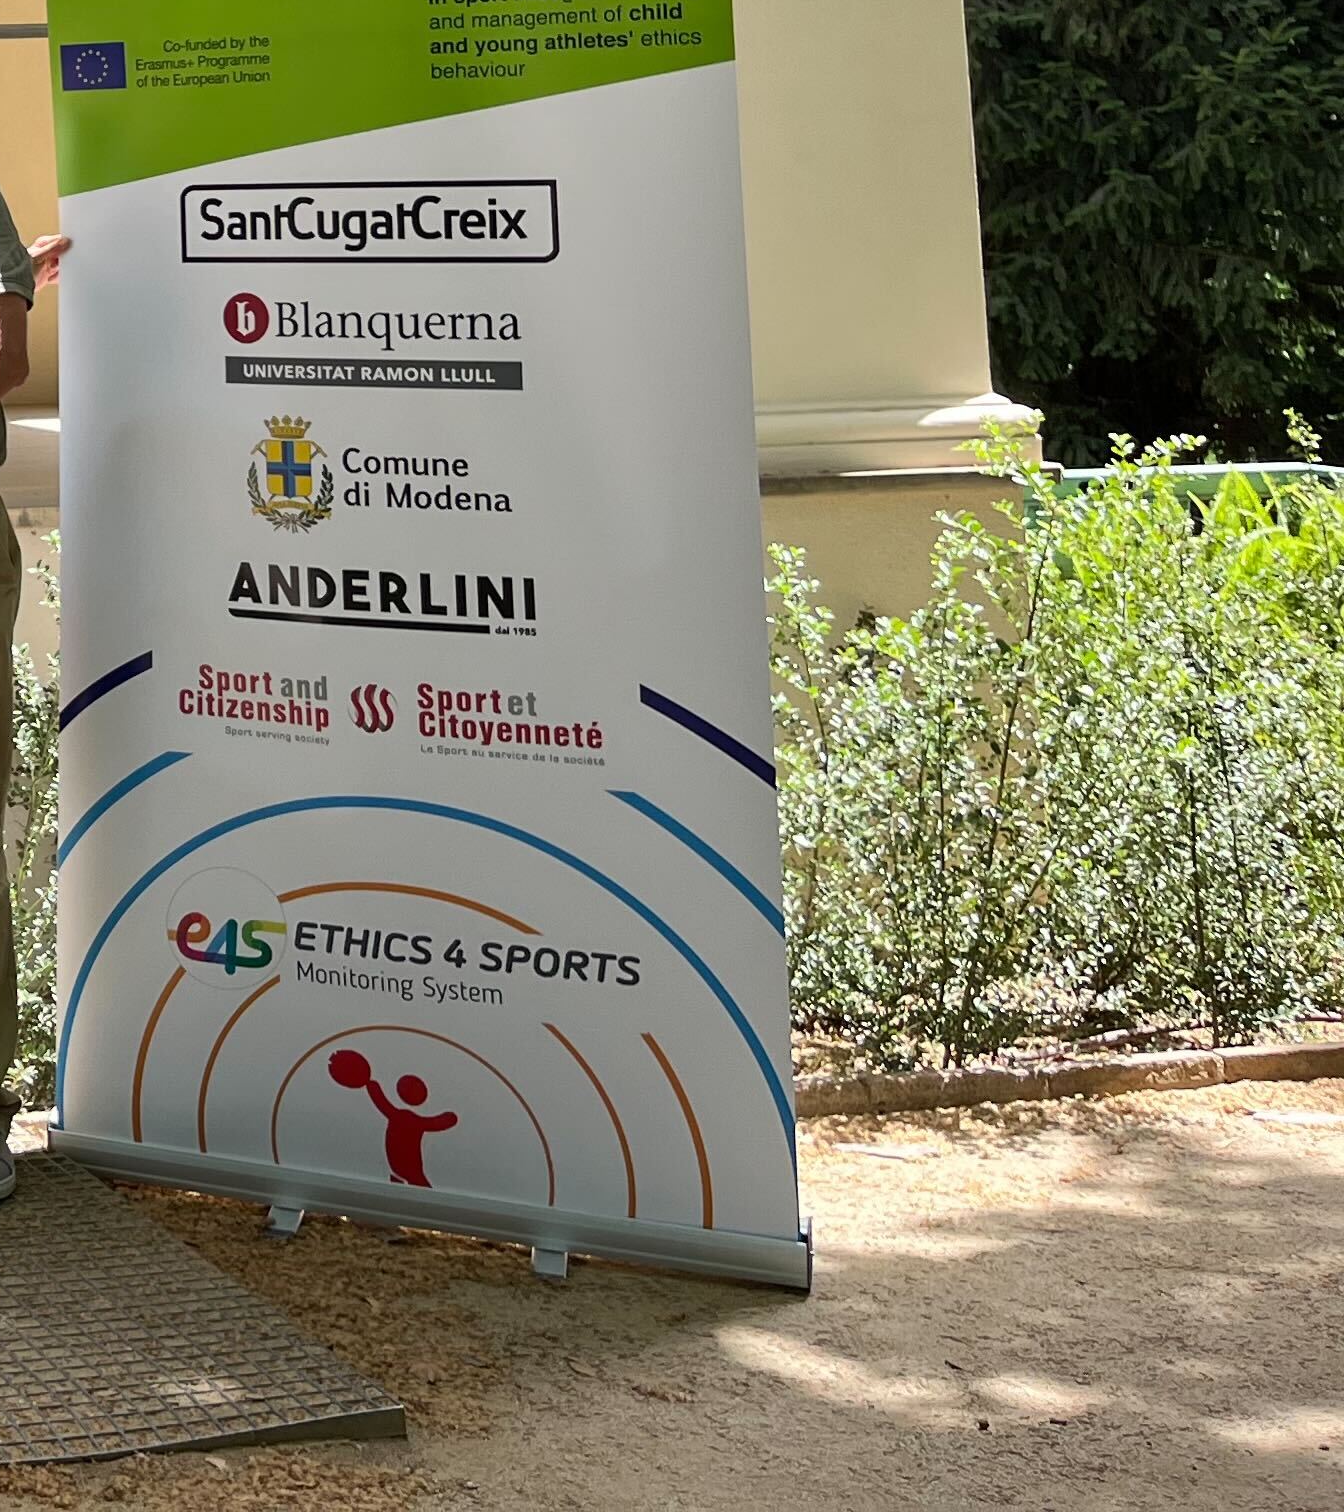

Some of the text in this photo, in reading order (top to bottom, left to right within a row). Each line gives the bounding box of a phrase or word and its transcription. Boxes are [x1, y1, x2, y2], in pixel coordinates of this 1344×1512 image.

[429, 3, 683, 30] and management of child
[163, 36, 270, 53] Co-funded by the
[430, 30, 702, 56] and young athletes' ethics
[135, 54, 270, 71] Erasmus+ Programme
[431, 63, 526, 80] behaviour
[136, 71, 270, 88] of the European Union
[200, 195, 528, 252] SantCugatCreix
[274, 301, 522, 351] Blanquerna
[243, 364, 496, 384] UNIVERSITAT RAMON LLULL
[342, 447, 469, 477] Comune
[343, 481, 513, 512] di Modena
[228, 561, 537, 620] ANDERLINI
[513, 627, 537, 637] 1985
[198, 664, 328, 700] Sport and
[179, 688, 330, 732] Citizenship
[417, 683, 537, 717] Sport et
[224, 725, 253, 737] Sport
[419, 711, 603, 749] Citoyenneté
[437, 745, 468, 757] Sport
[293, 921, 642, 986] ETHICS 4 SPORTS
[296, 960, 504, 1005] Monitoring System
